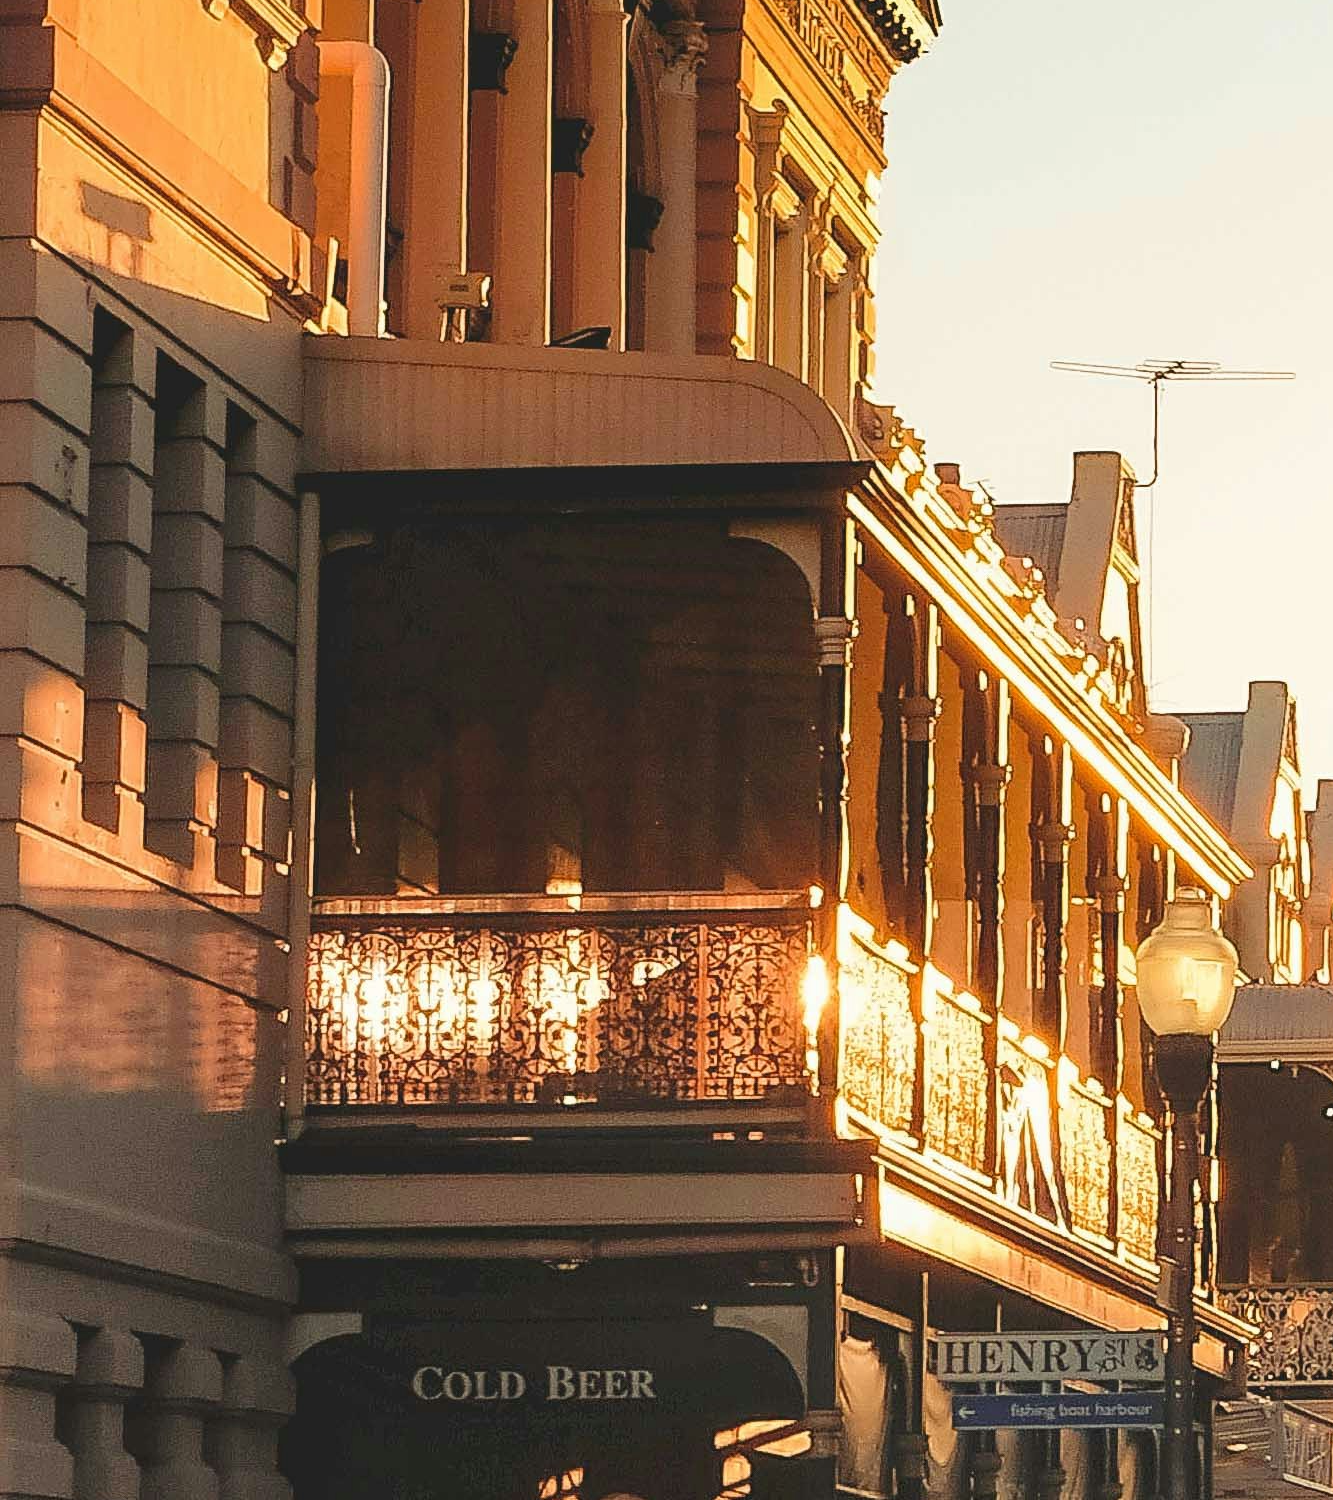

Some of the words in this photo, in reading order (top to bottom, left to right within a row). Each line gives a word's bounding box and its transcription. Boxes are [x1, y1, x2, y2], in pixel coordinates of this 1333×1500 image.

[943, 1339, 1100, 1374] HENRY
[413, 1366, 526, 1400] COLD
[546, 1365, 657, 1400] BEER
[1010, 1403, 1056, 1419] fishing
[1059, 1403, 1092, 1416] boat
[1095, 1402, 1153, 1416] harbour
